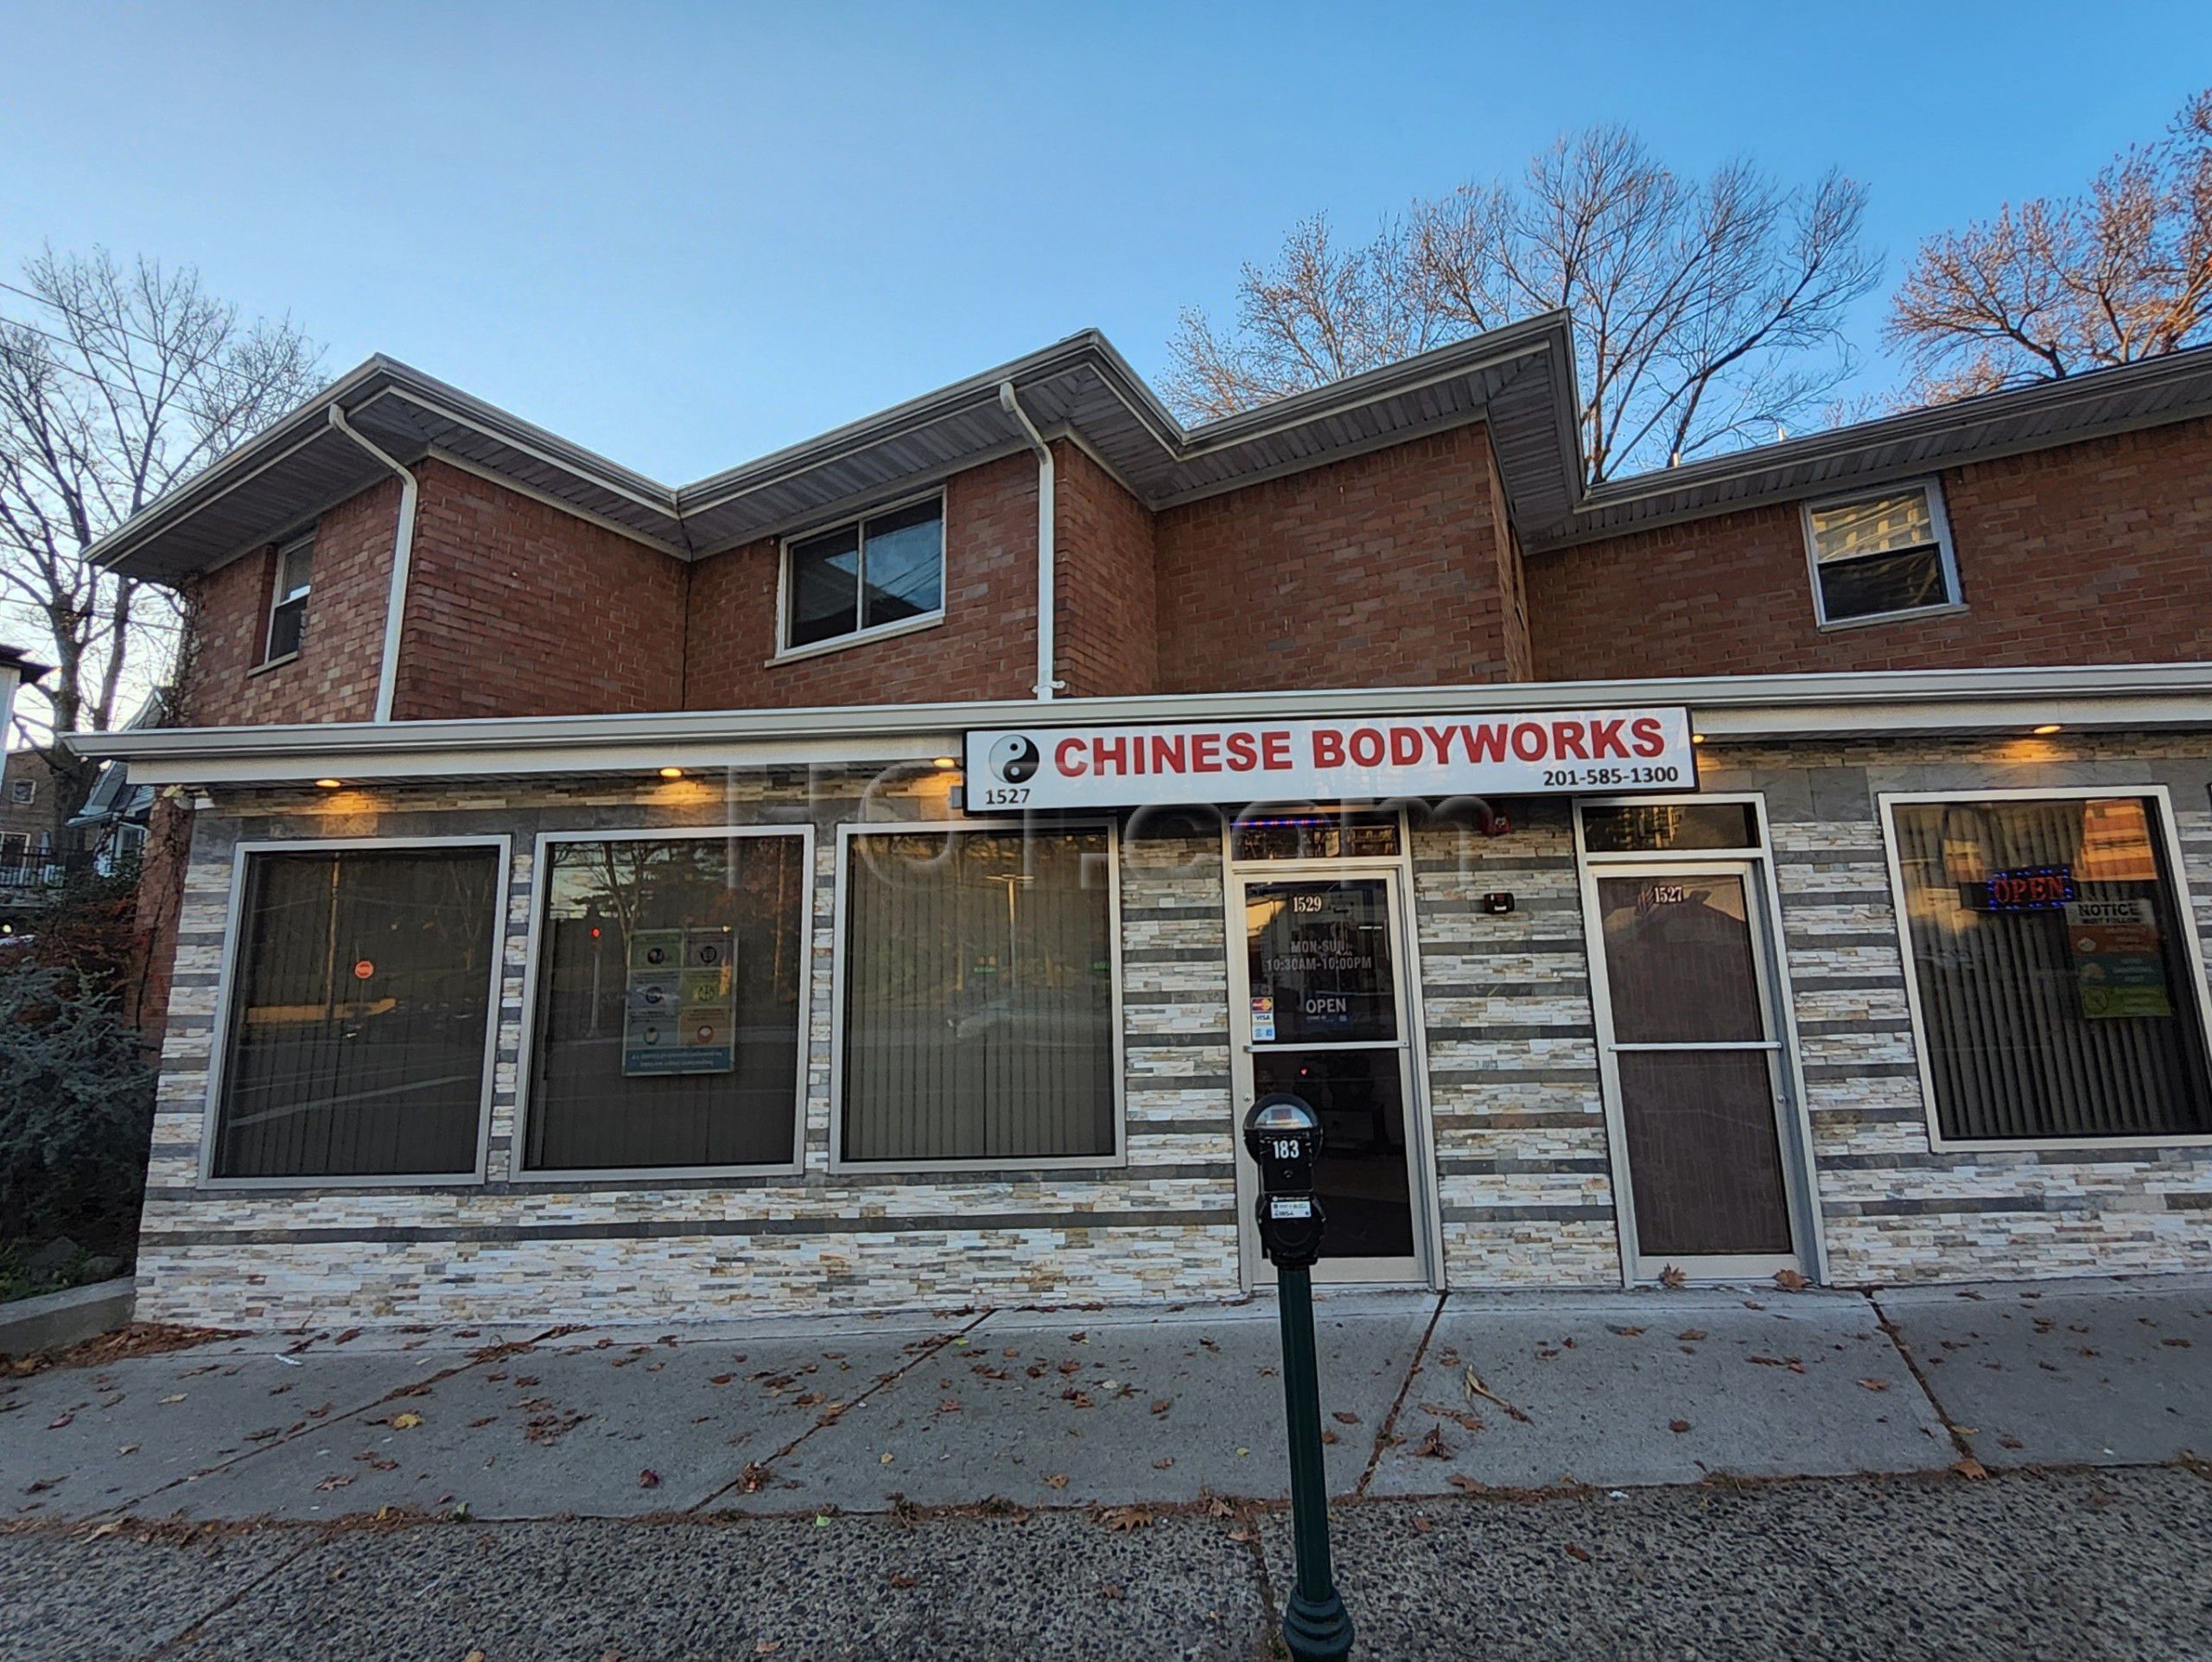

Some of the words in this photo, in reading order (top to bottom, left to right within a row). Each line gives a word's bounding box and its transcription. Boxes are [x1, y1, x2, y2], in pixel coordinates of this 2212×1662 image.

[1054, 729, 1293, 778] CHINESE
[1312, 716, 1666, 770] BODYWORKS
[1542, 765, 1679, 788] 201-585-1300
[984, 787, 1031, 806] 1527
[1654, 886, 1683, 903] 1527
[1994, 876, 2066, 903] OPEN
[1293, 896, 1322, 913] 1529
[2078, 902, 2142, 917] NOTICE
[1266, 955, 1372, 971] 10:30AM-10:00PM
[1306, 997, 1347, 1014] OPEN
[1273, 1139, 1300, 1159] 183
